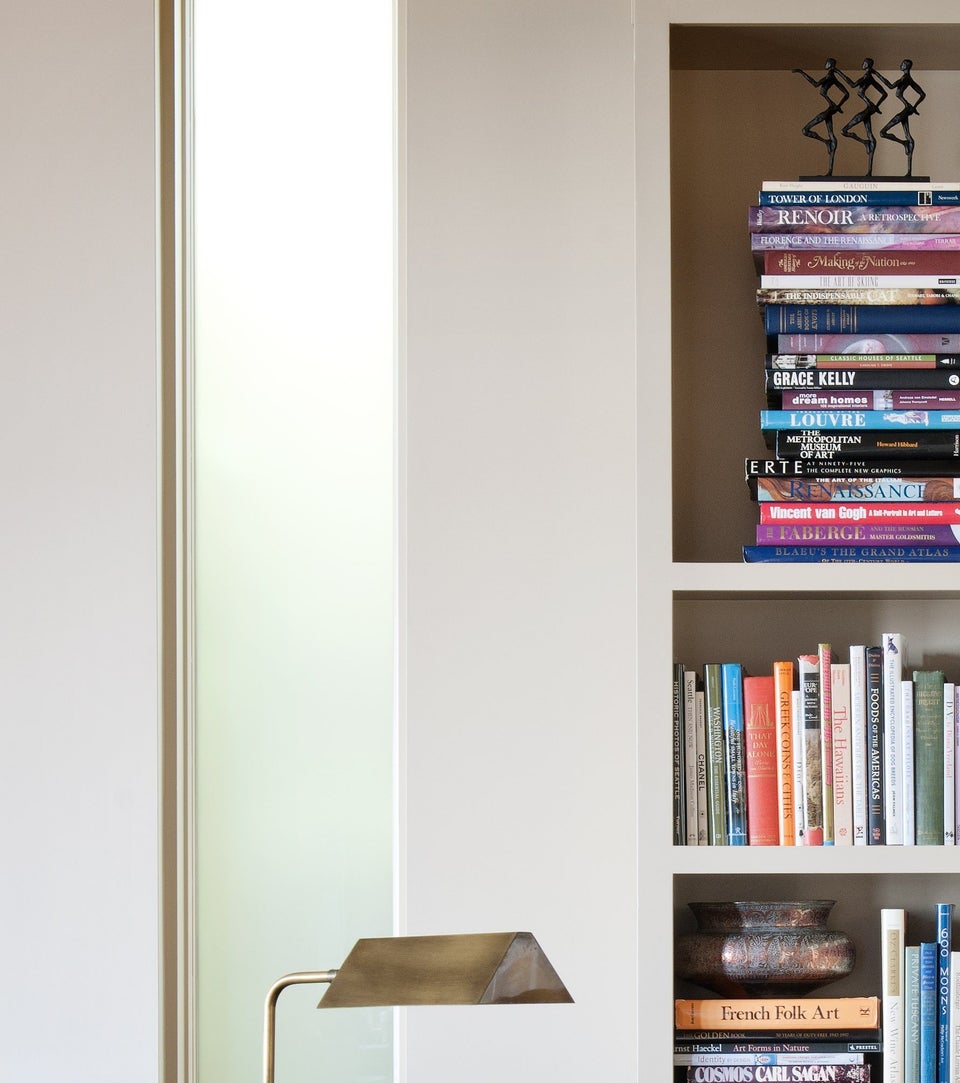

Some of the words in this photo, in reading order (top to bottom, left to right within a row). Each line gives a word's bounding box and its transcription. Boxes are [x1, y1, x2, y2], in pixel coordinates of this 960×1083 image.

[768, 195, 805, 203] TOWER
[808, 195, 823, 203] OF
[824, 195, 868, 203] LONDON
[777, 209, 854, 225] RENOIR
[861, 213, 868, 221] A
[868, 213, 941, 222] RETROSPECTIVE
[773, 372, 813, 386] GRACE
[819, 371, 856, 386] KELLY
[830, 396, 868, 404] homes
[790, 414, 866, 427] LOUVRE
[786, 436, 862, 444] METROPOLITAN
[801, 443, 841, 451] MUSEUM
[800, 451, 815, 459] OF
[816, 451, 835, 459] ART
[750, 461, 803, 474] ERTE
[770, 506, 812, 519] Vincent
[815, 507, 835, 519] van
[838, 506, 867, 521] Gogh
[687, 679, 695, 703] Seattle
[870, 688, 880, 723] FOODS
[833, 706, 848, 734] The
[713, 706, 722, 763] WASHINGTON
[872, 724, 878, 734] OF
[834, 738, 849, 806] Hawaiians
[871, 748, 880, 800] AMERICAS
[940, 927, 948, 957] 600
[940, 967, 949, 1015] MOONS
[721, 1005, 770, 1020] French
[775, 1005, 807, 1020] Folk
[812, 1005, 840, 1020] Art
[692, 1044, 722, 1052] Haeckel
[733, 1044, 746, 1052] Art
[748, 1044, 772, 1052] Forms
[773, 1044, 781, 1052] in
[782, 1044, 810, 1052] Nature
[694, 1066, 753, 1083] COSMOS
[754, 1066, 791, 1083] CARL
[792, 1066, 836, 1083] SAGAN
